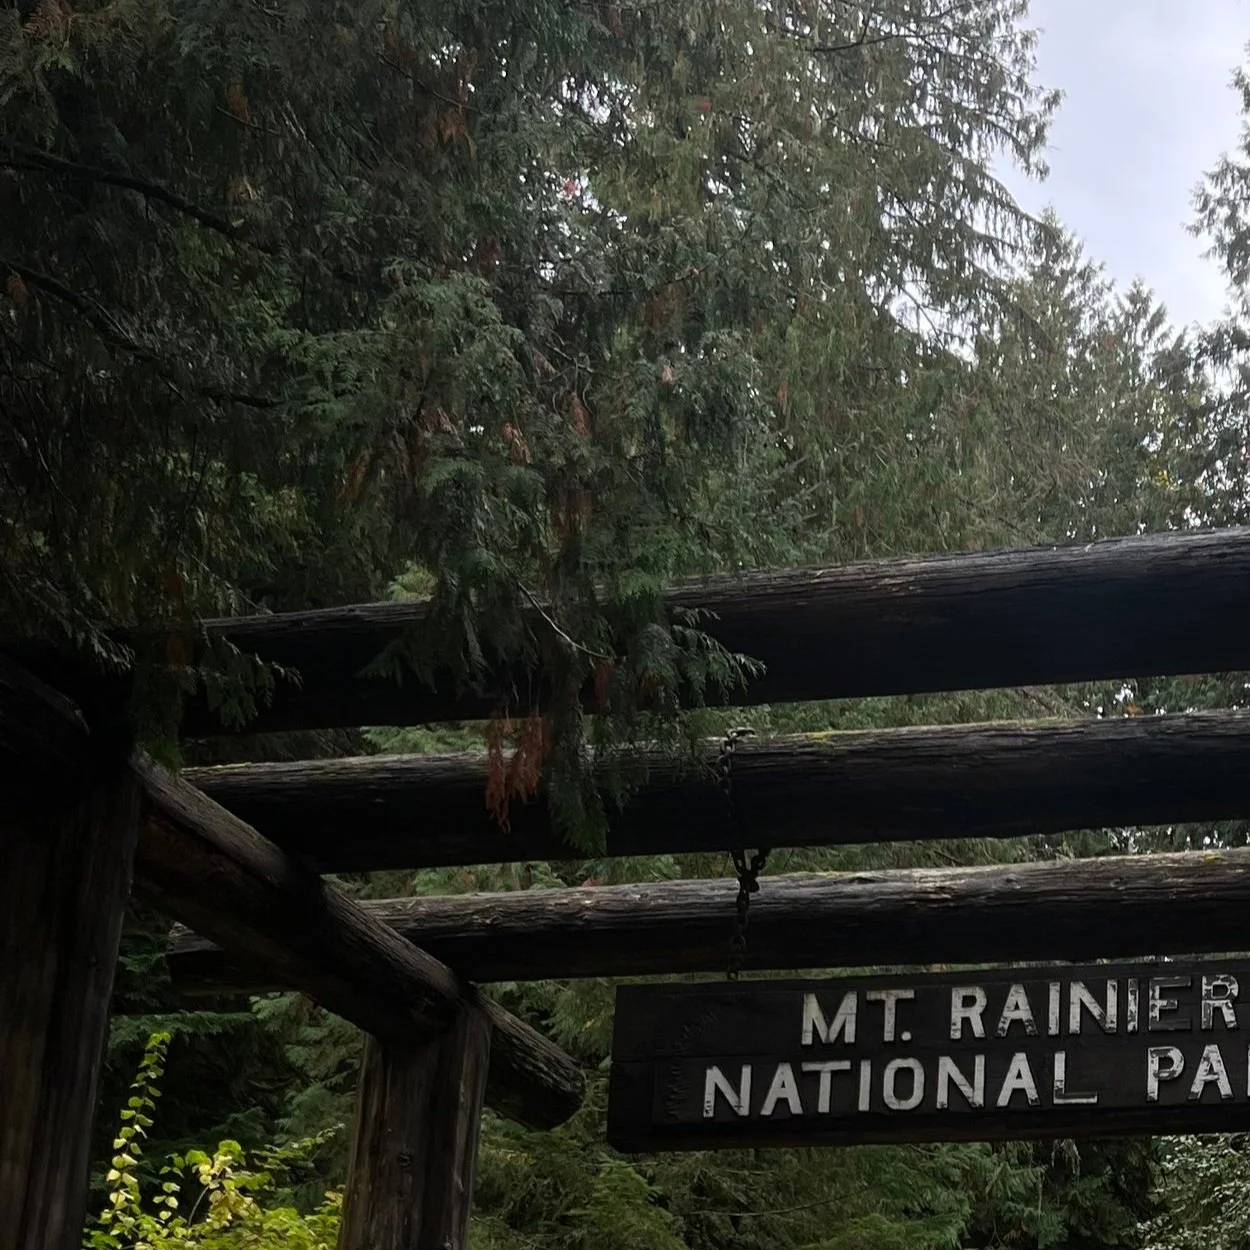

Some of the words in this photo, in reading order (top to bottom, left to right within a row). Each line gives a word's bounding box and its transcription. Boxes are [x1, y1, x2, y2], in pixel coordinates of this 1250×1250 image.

[800, 988, 916, 1047] MT.
[949, 973, 1241, 1042] RAINIER
[703, 1050, 1099, 1119] NATIONAL
